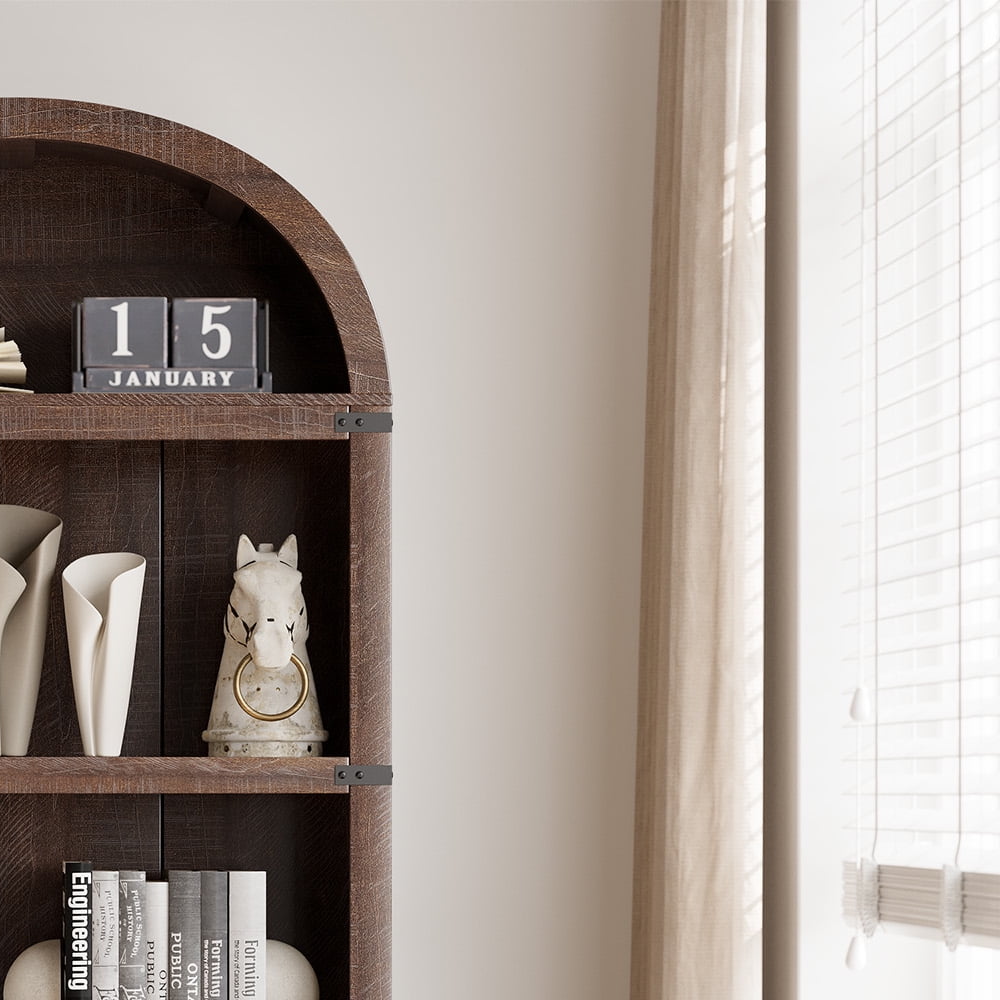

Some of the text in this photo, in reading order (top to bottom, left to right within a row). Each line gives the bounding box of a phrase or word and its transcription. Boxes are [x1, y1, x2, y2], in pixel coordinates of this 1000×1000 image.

[110, 301, 232, 359] 1 5
[108, 371, 234, 386] JANUARY
[68, 872, 92, 991] Engineering
[126, 905, 134, 942] HISTORY
[130, 890, 143, 958] PUBLIC SCHOOL
[146, 941, 155, 994] PUBLIC
[171, 932, 182, 990] PUBLIC
[210, 939, 223, 997] Forming
[241, 939, 259, 997] Forming
